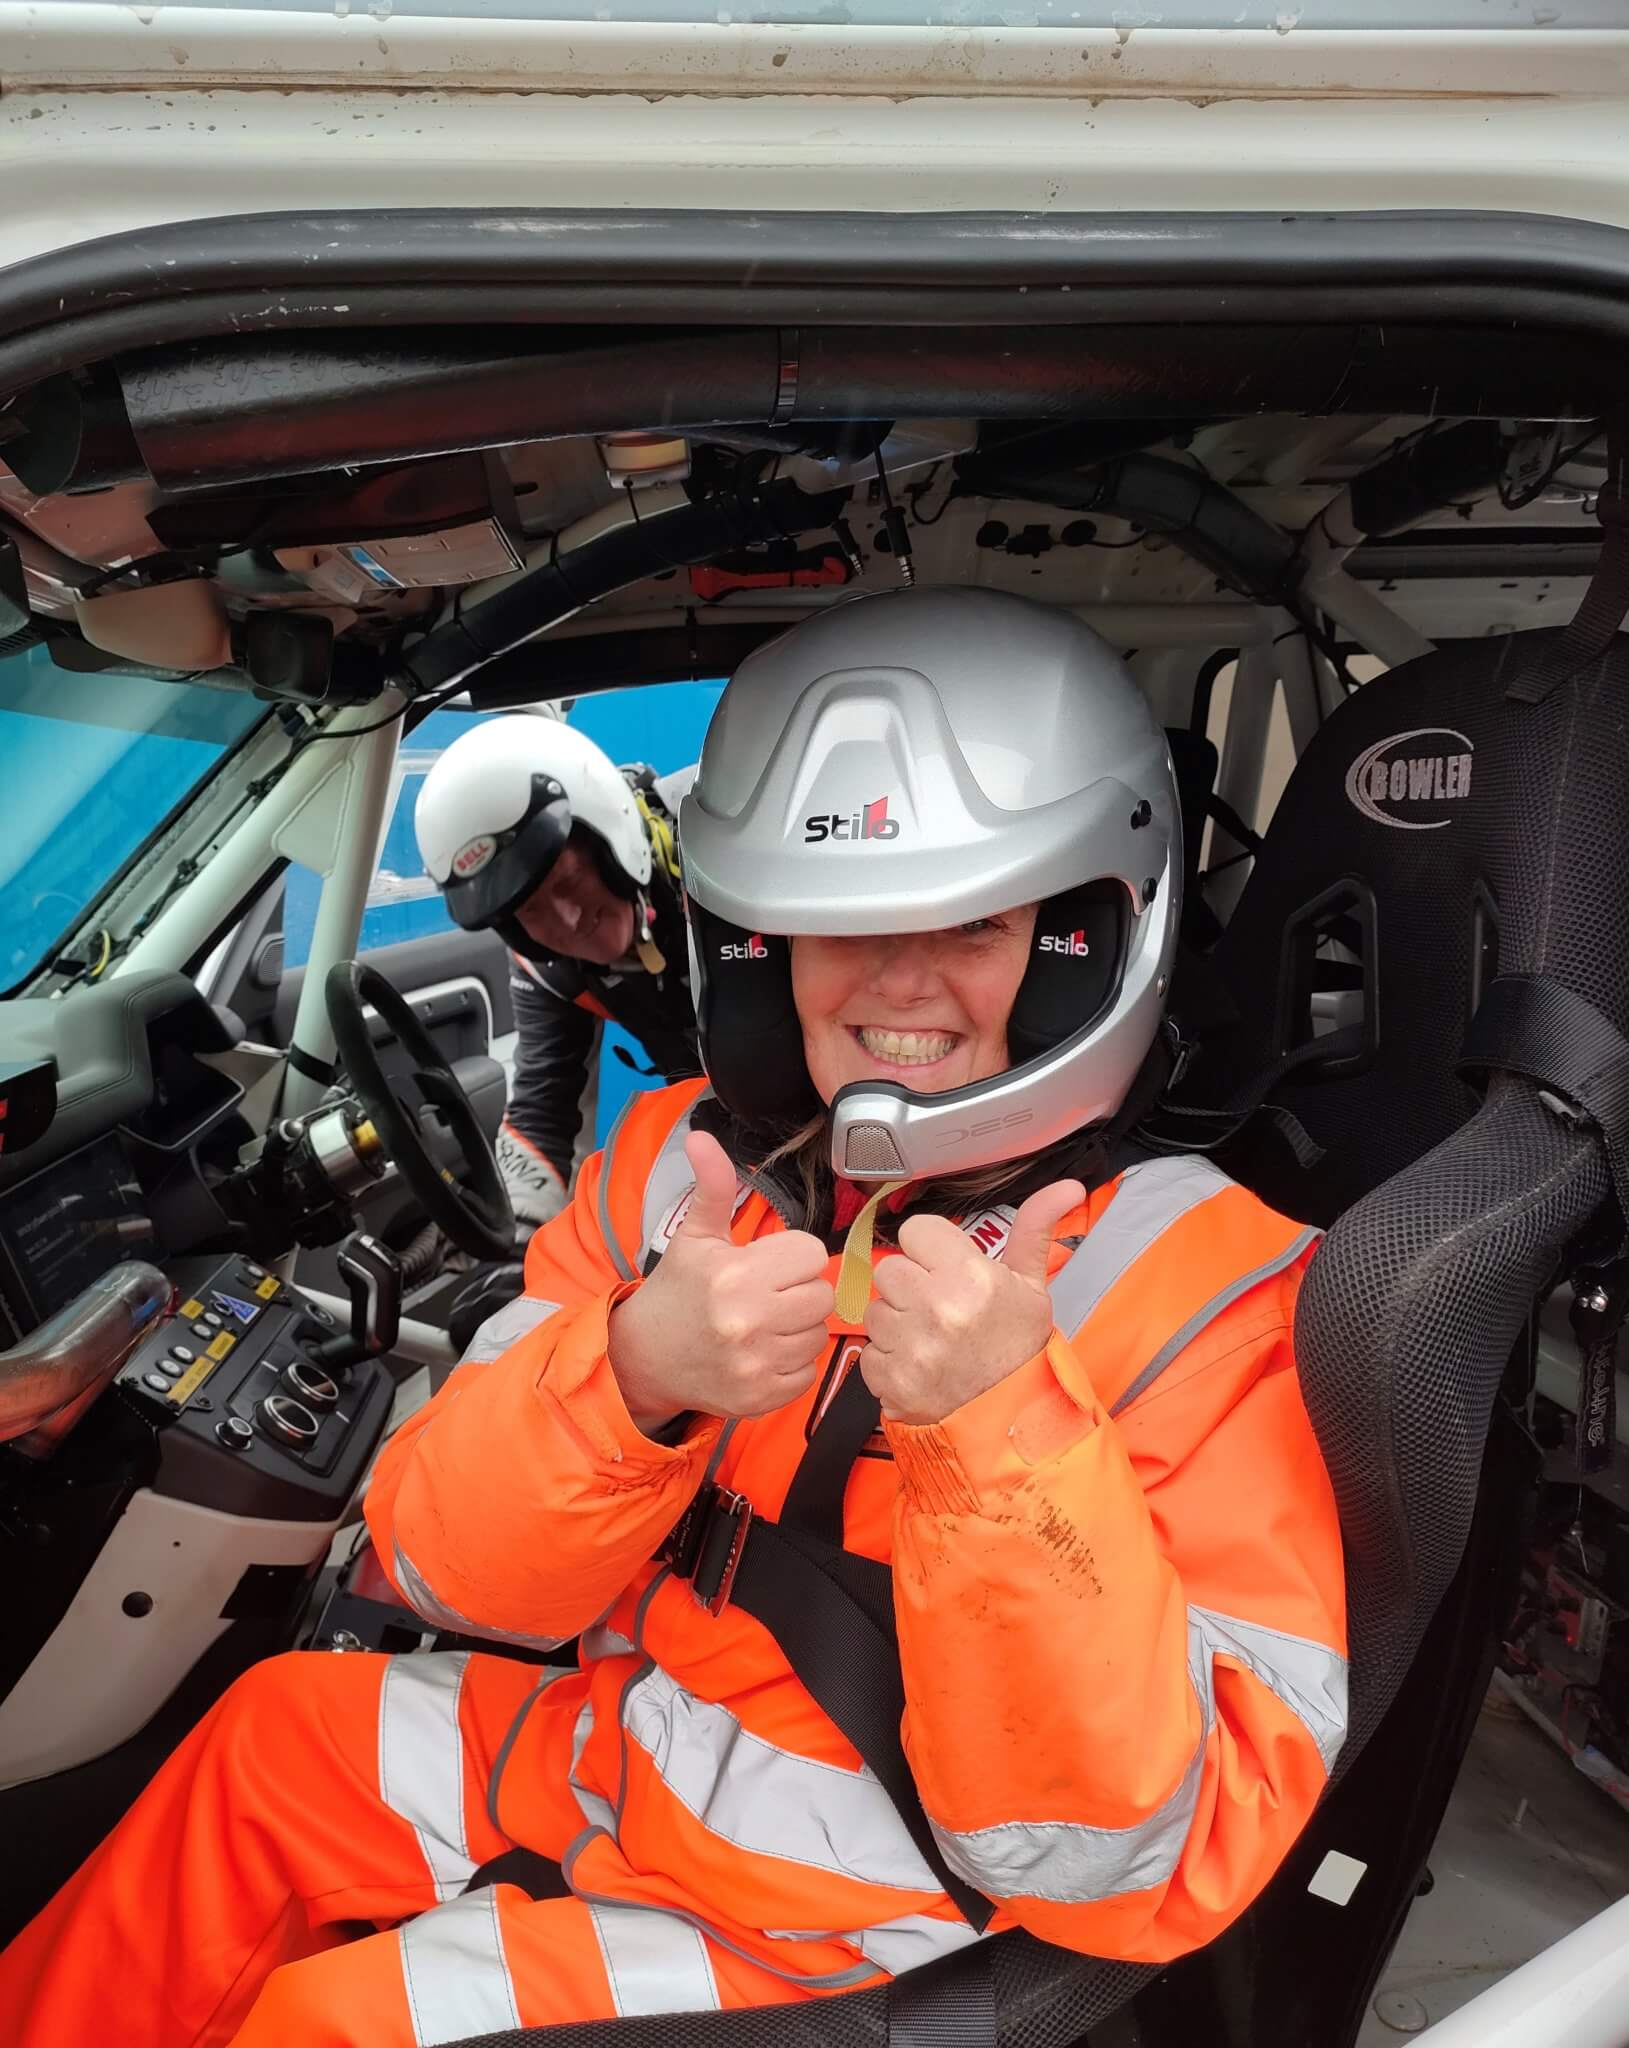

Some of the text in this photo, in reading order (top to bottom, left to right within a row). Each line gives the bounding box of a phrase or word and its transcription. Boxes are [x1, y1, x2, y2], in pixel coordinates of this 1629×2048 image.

[1369, 753, 1473, 801] BOWLER
[804, 796, 900, 843] Stilo
[455, 841, 489, 872] BELL
[719, 935, 769, 960] Stilo
[1038, 930, 1089, 957] Stilo
